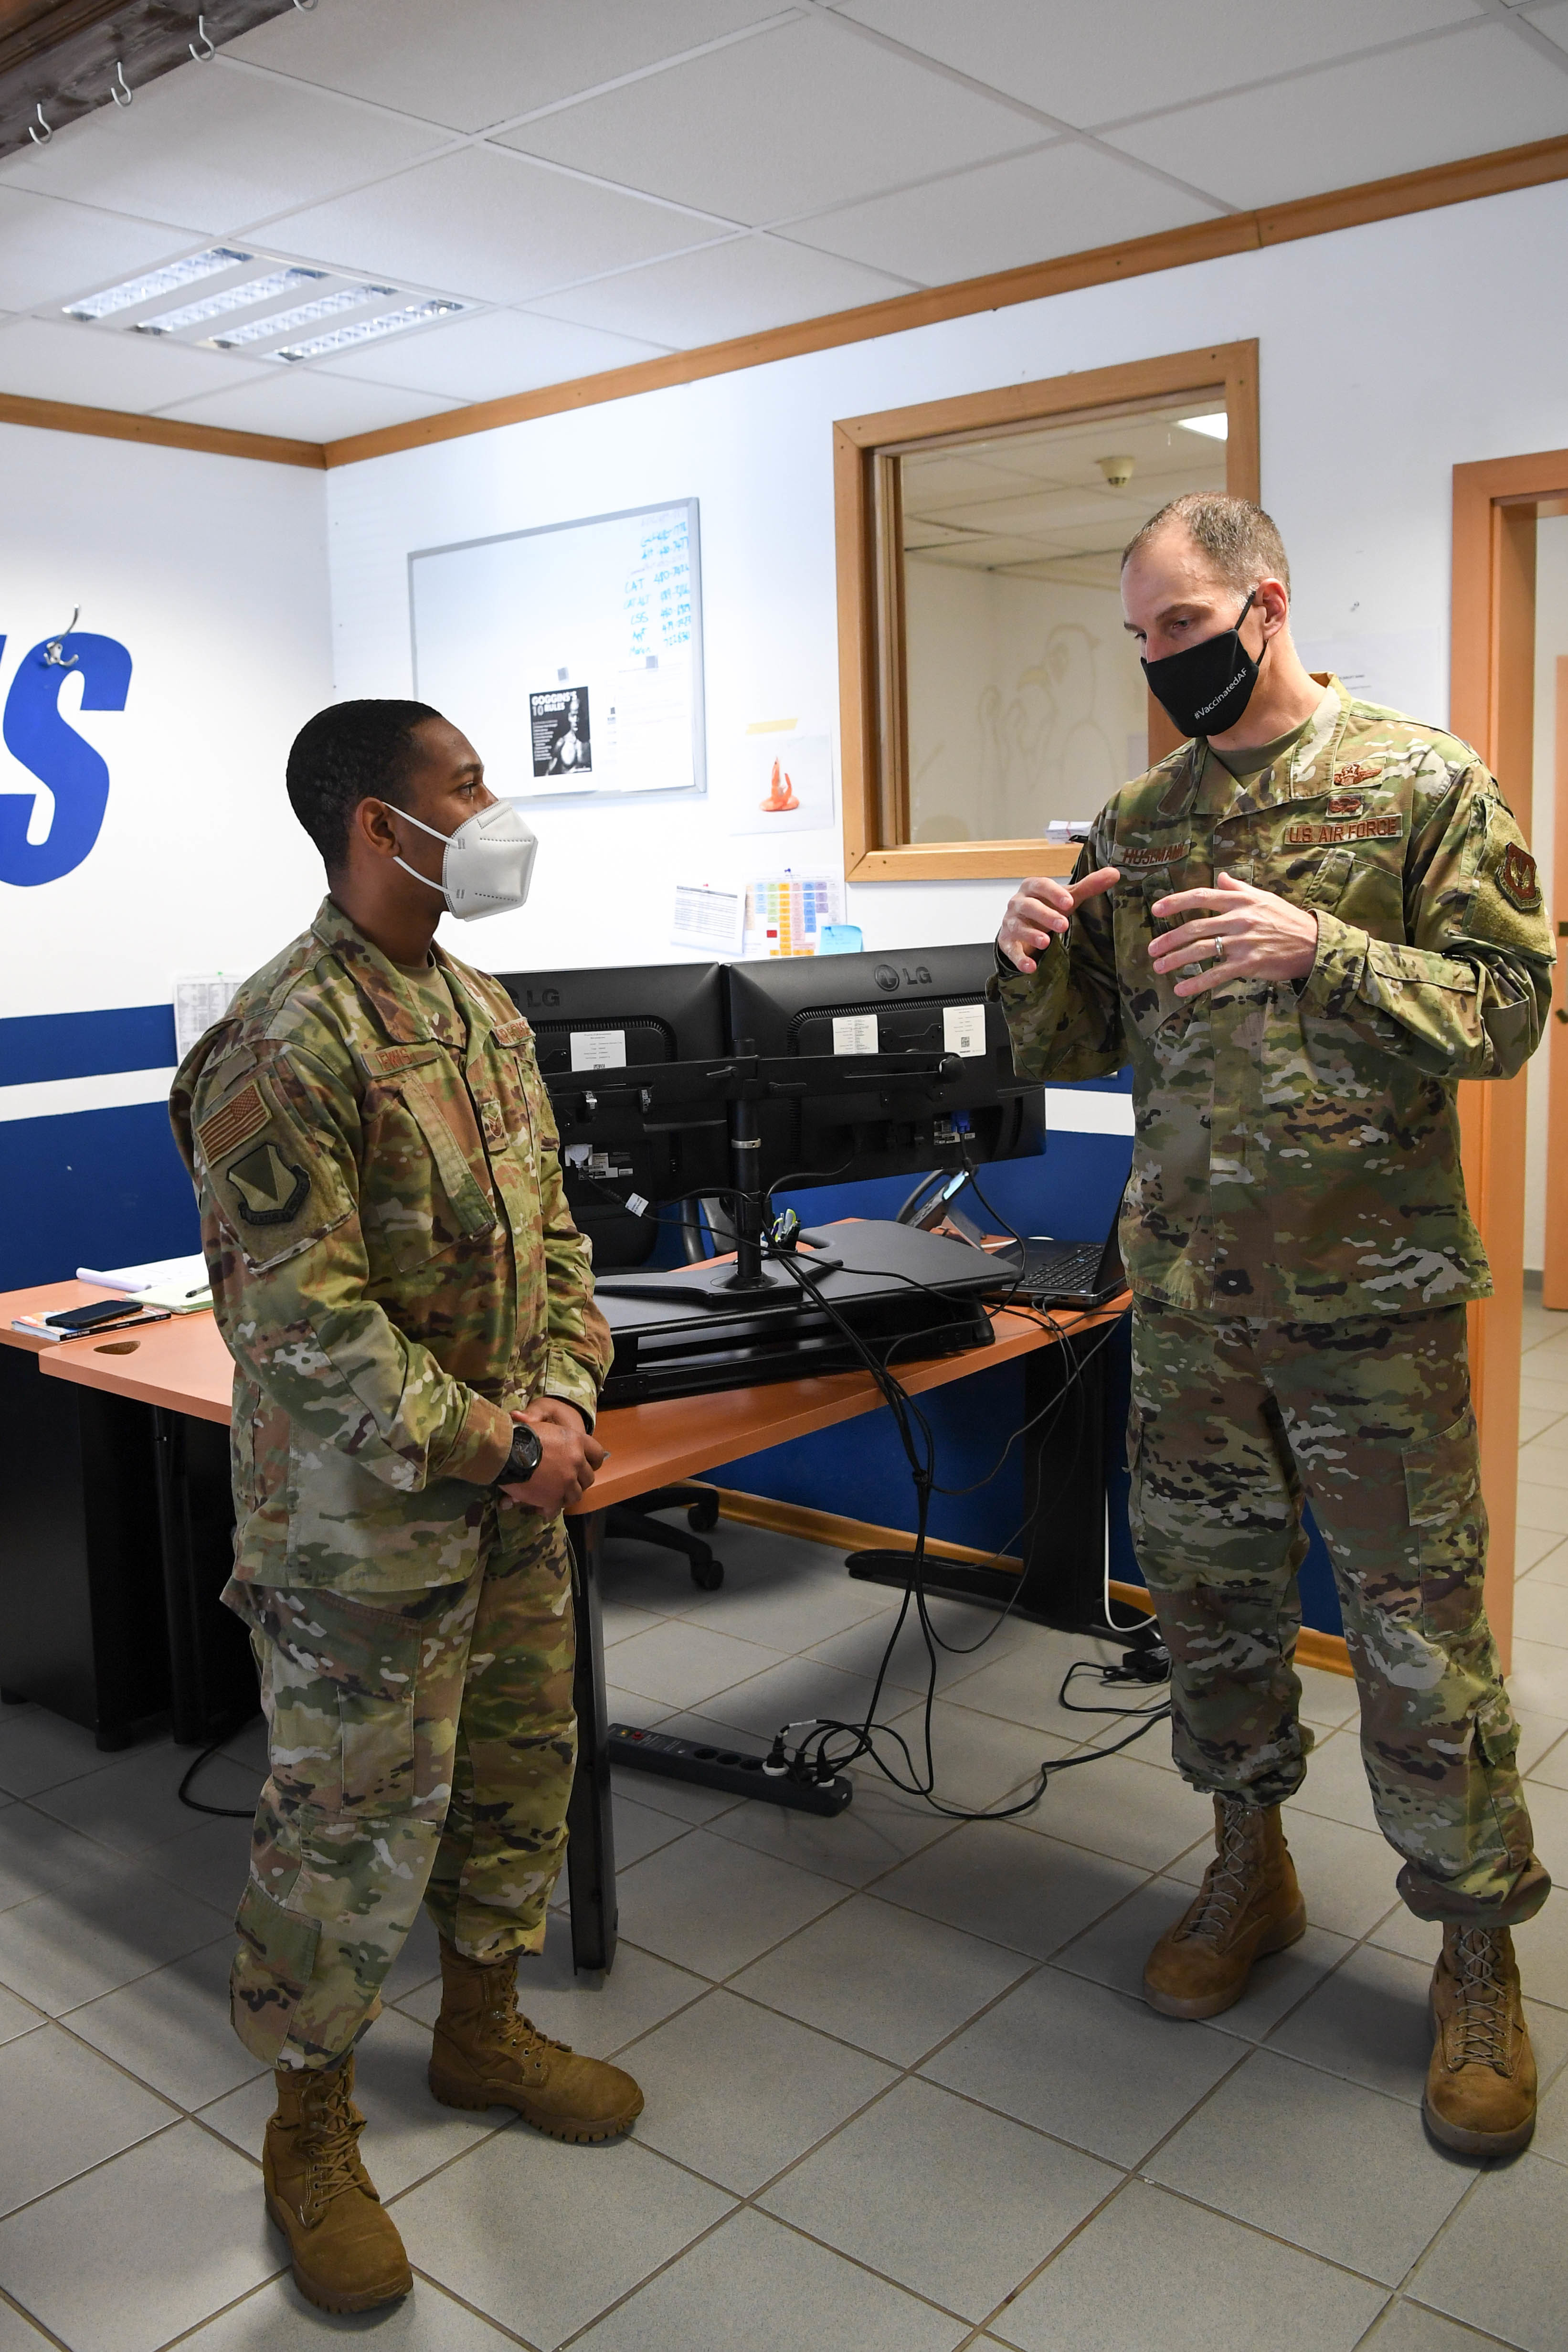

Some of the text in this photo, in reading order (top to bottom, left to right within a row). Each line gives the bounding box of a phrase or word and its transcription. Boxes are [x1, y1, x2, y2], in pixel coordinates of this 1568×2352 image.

[531, 691, 577, 706] GOGGINS'S
[1194, 667, 1248, 720] #VaccinatedAF
[532, 702, 566, 717] 10 RULES
[0, 632, 132, 887] S
[1289, 817, 1397, 843] U.S. AIR FORCE
[902, 966, 932, 985] LG
[527, 988, 560, 1007] LG
